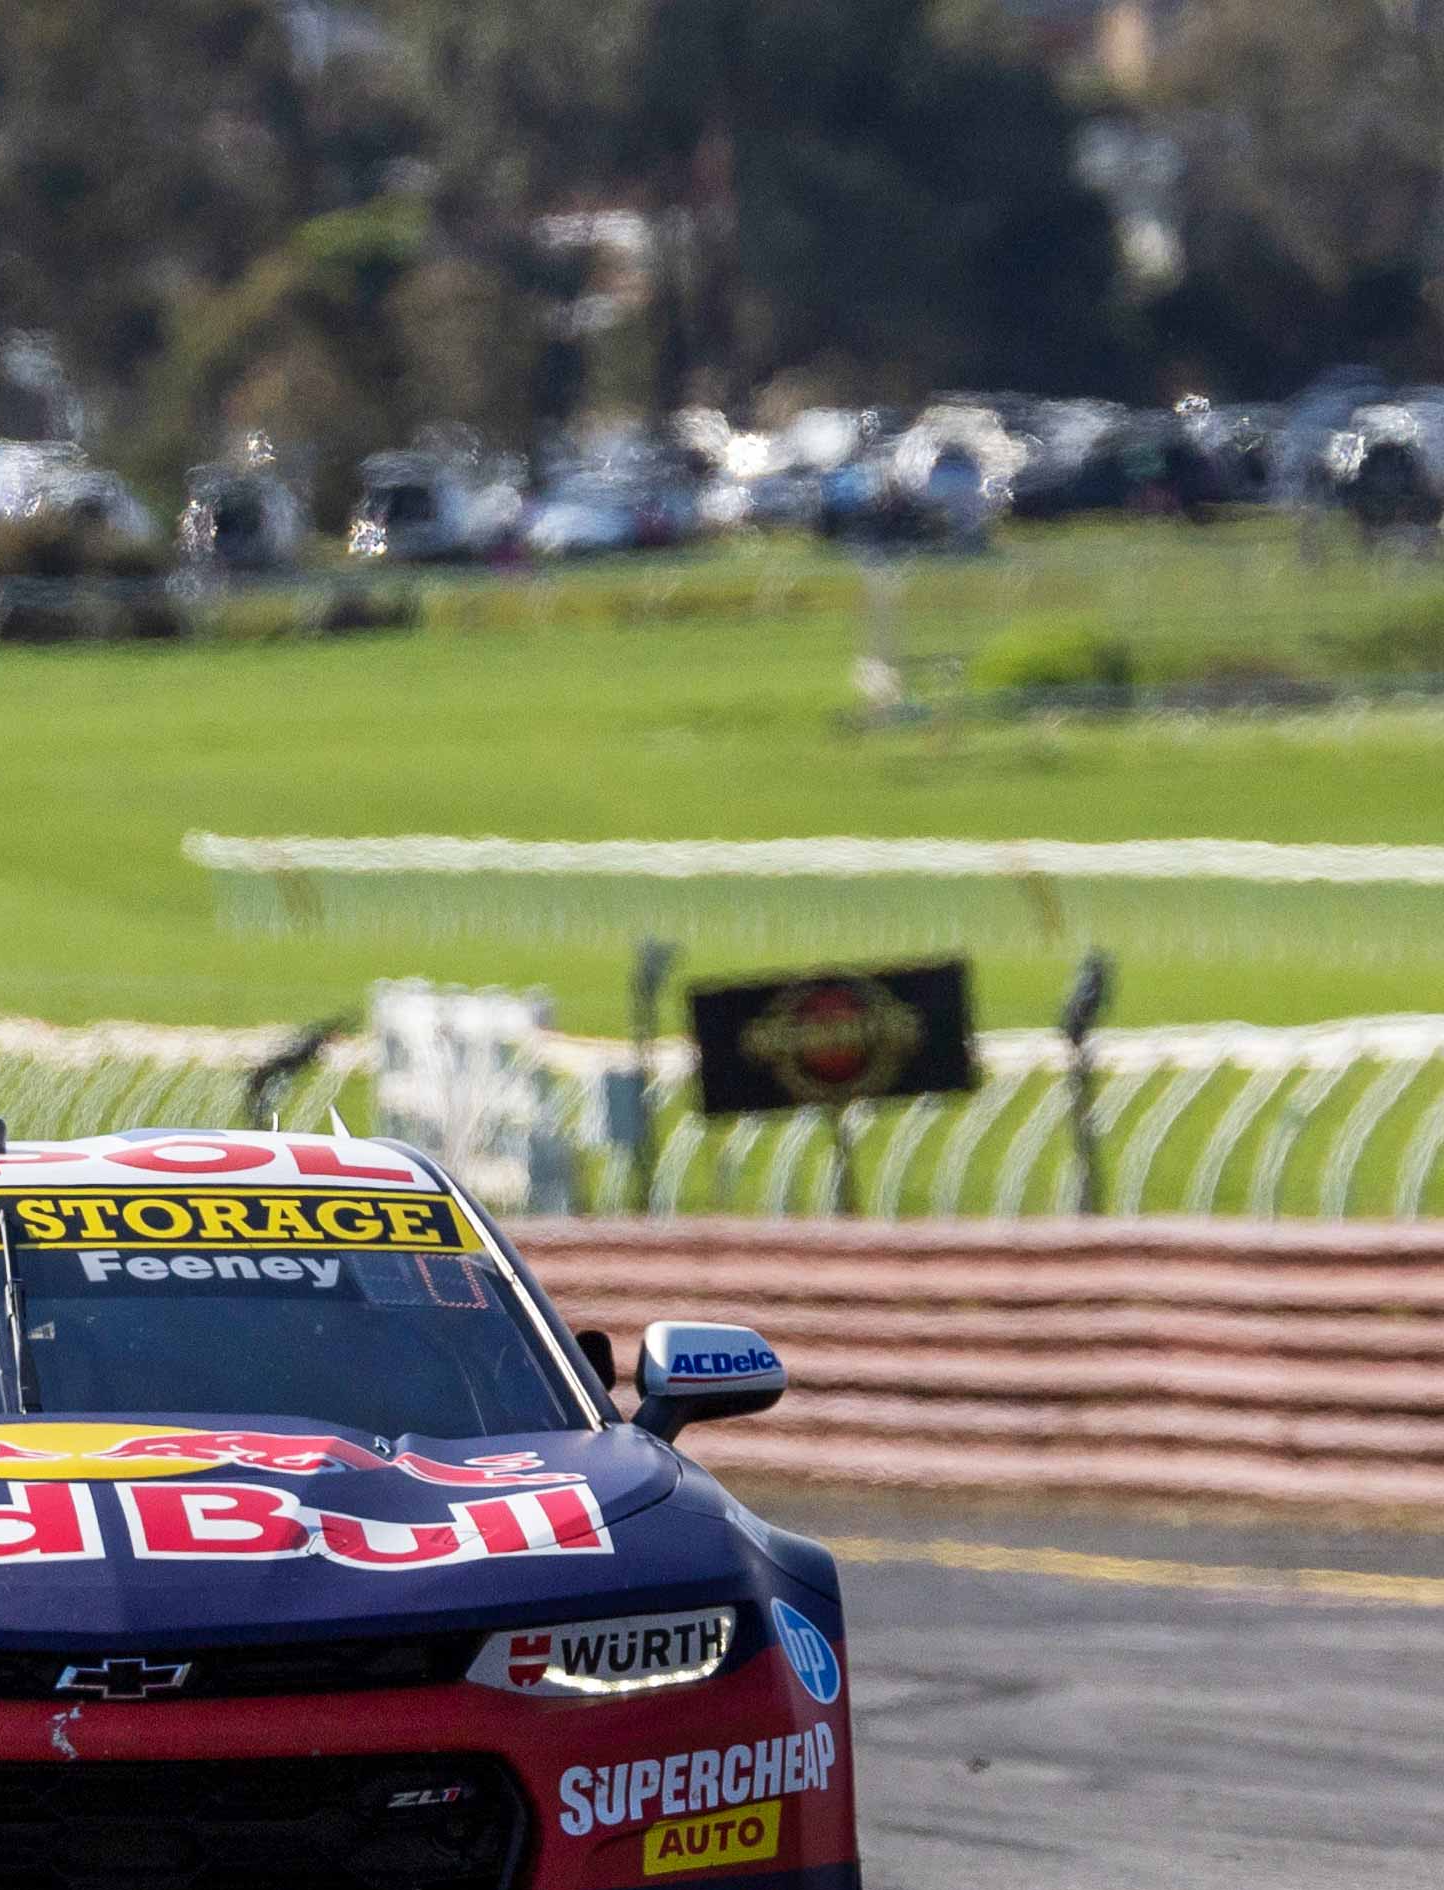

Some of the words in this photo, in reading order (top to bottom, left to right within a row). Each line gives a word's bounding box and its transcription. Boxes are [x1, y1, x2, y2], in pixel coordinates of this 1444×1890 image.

[17, 1196, 444, 1245] STORAGE
[79, 1251, 342, 1289] Feeney
[116, 1481, 615, 1573] Bull
[561, 1617, 725, 1675] WÜRTH
[786, 1623, 828, 1700] hp
[388, 1786, 461, 1808] ZL1
[558, 1721, 836, 1837] SUPERCHEAP
[657, 1816, 766, 1860] AUTO
